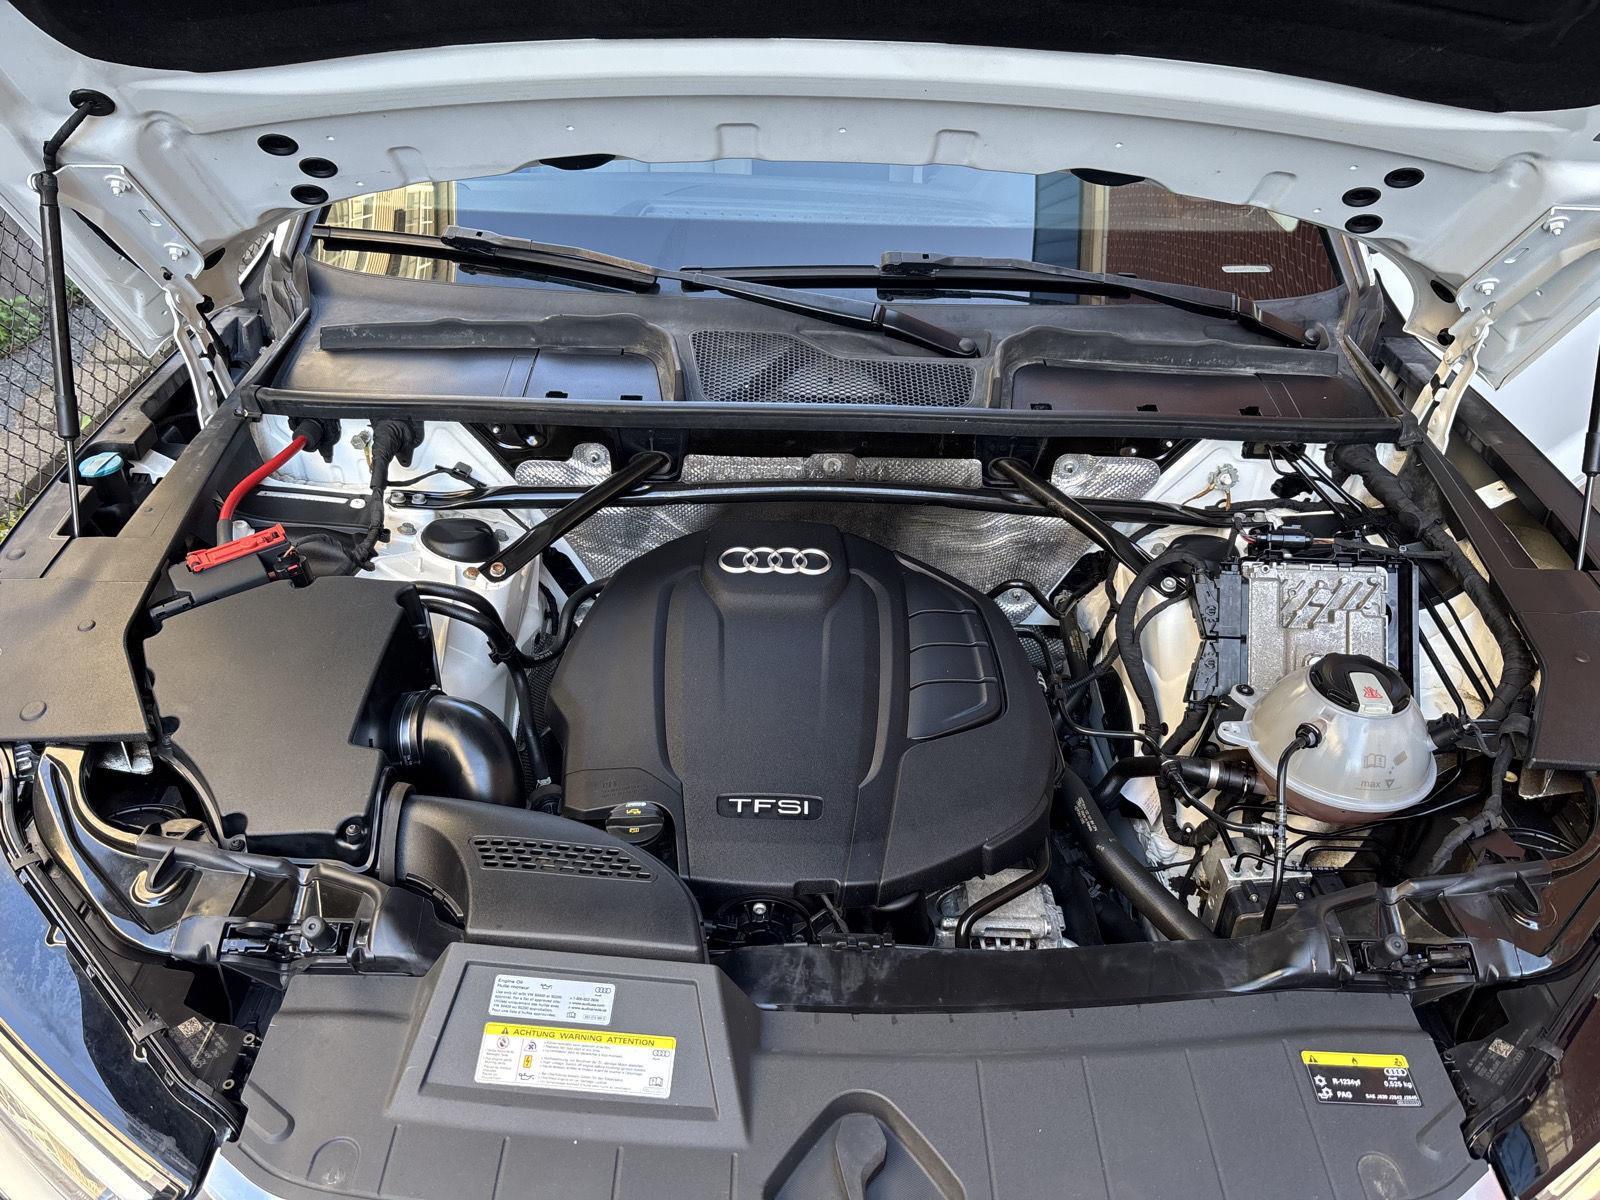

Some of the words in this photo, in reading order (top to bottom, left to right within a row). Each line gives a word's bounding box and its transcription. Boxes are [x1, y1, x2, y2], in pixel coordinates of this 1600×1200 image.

[1361, 780, 1380, 788] max
[728, 798, 809, 815] TFSI
[513, 1028, 555, 1039] ACHTUNG
[559, 1032, 602, 1042] WARNING
[606, 1036, 655, 1046] ATTENTION
[1337, 1091, 1353, 1099] PAG
